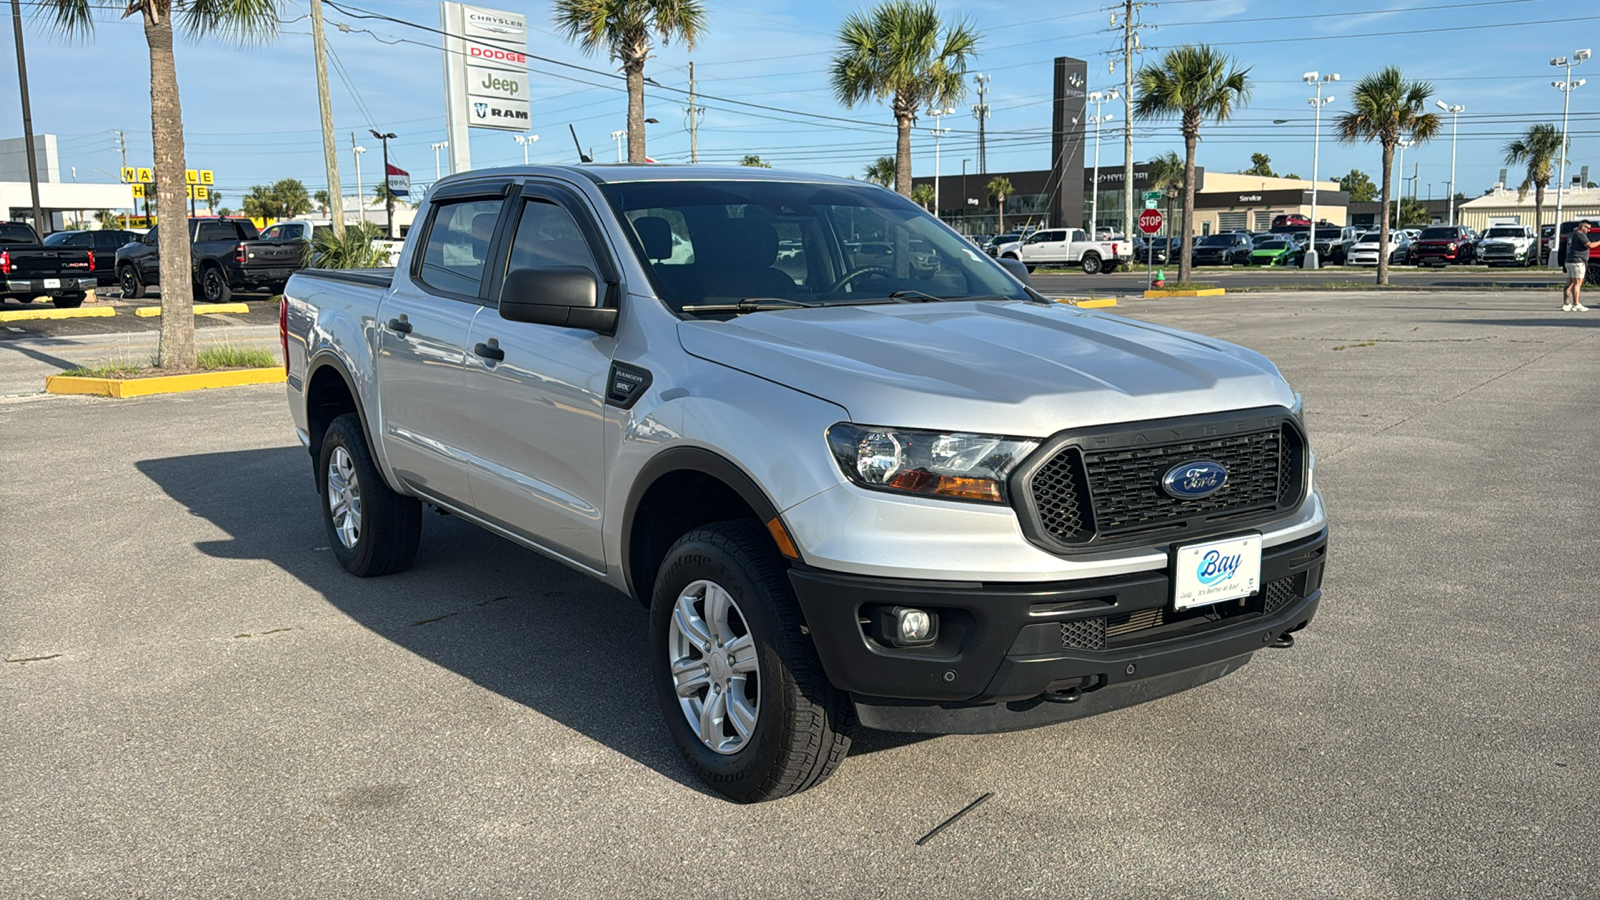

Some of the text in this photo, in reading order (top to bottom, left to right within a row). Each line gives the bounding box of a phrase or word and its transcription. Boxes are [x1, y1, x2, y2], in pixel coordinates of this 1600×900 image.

[470, 14, 523, 28] CHRYSLER
[470, 47, 526, 63] DODGE
[481, 73, 519, 95] Jeep
[491, 108, 529, 120] RAM
[1140, 215, 1161, 227] STOP
[616, 370, 643, 382] RANGER
[1095, 415, 1277, 448] RANGER
[1183, 467, 1218, 490] Ford
[1200, 549, 1243, 579] Bay
